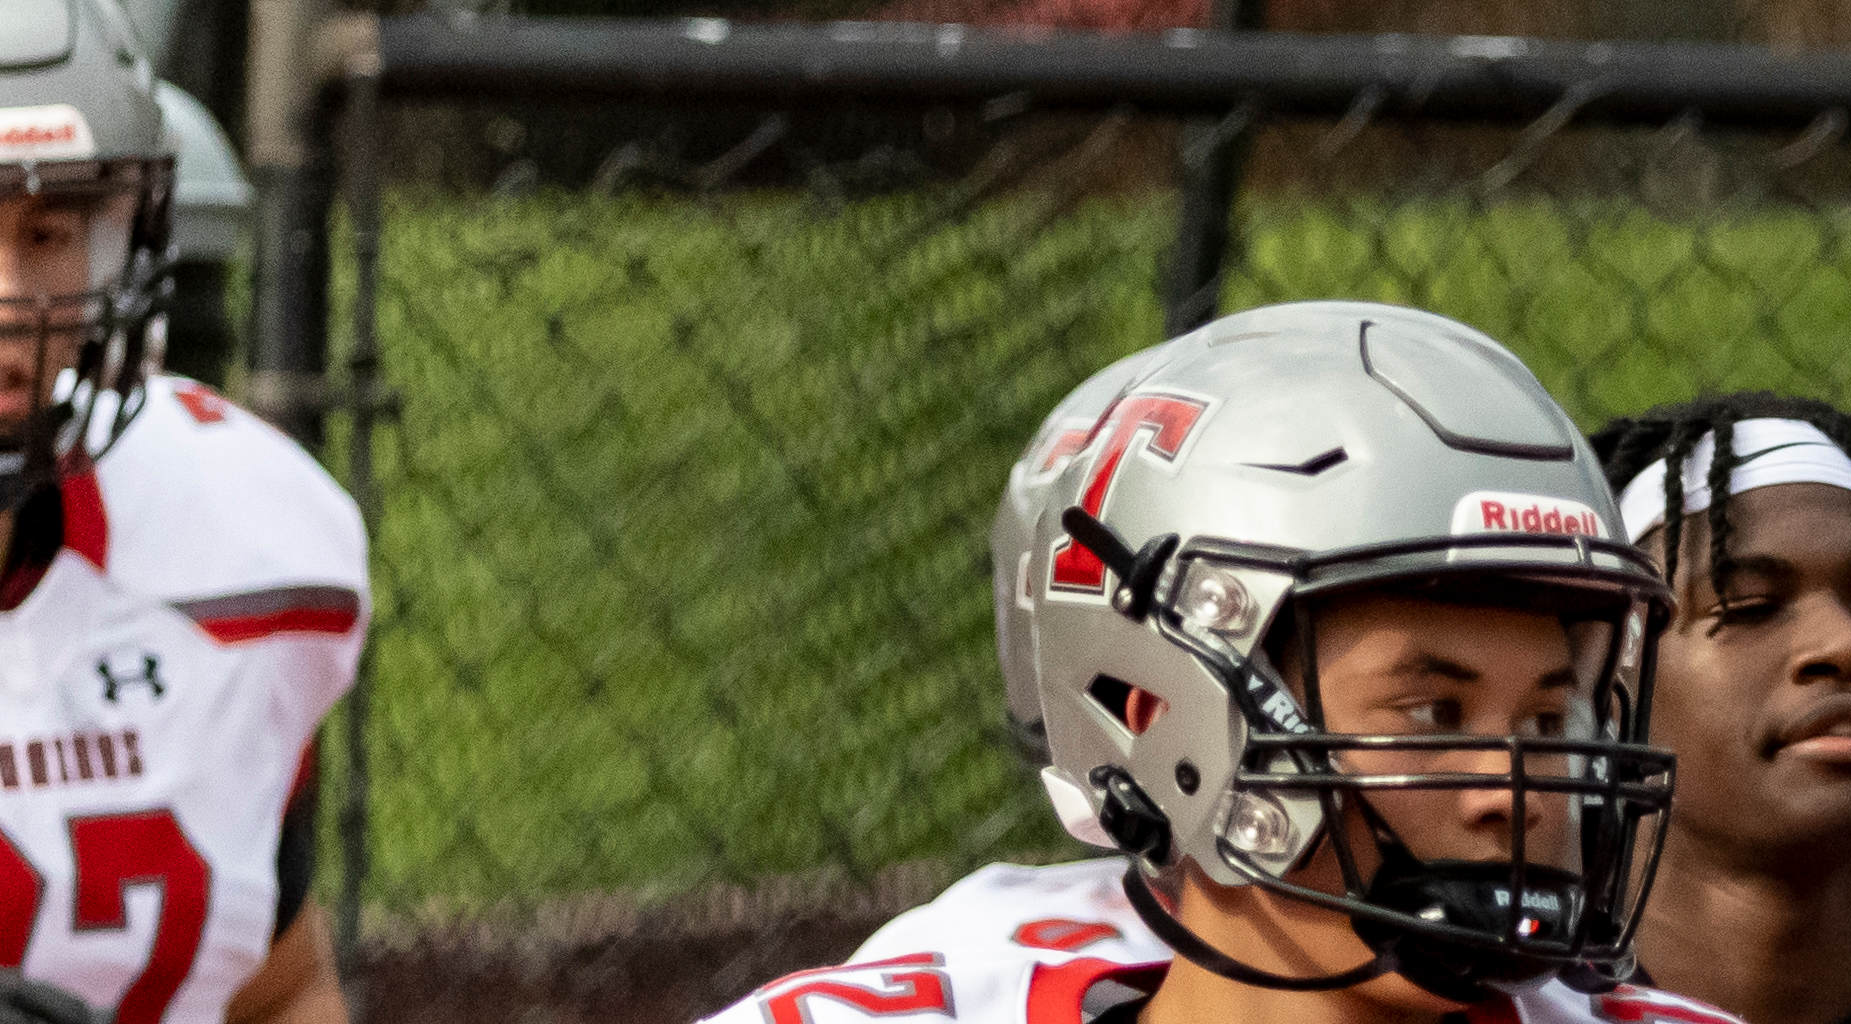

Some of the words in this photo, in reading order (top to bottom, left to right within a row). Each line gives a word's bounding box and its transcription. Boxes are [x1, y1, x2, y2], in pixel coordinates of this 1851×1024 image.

[1047, 387, 1220, 605] T
[1480, 499, 1600, 537] Riddell
[1494, 888, 1560, 912] Rddell
